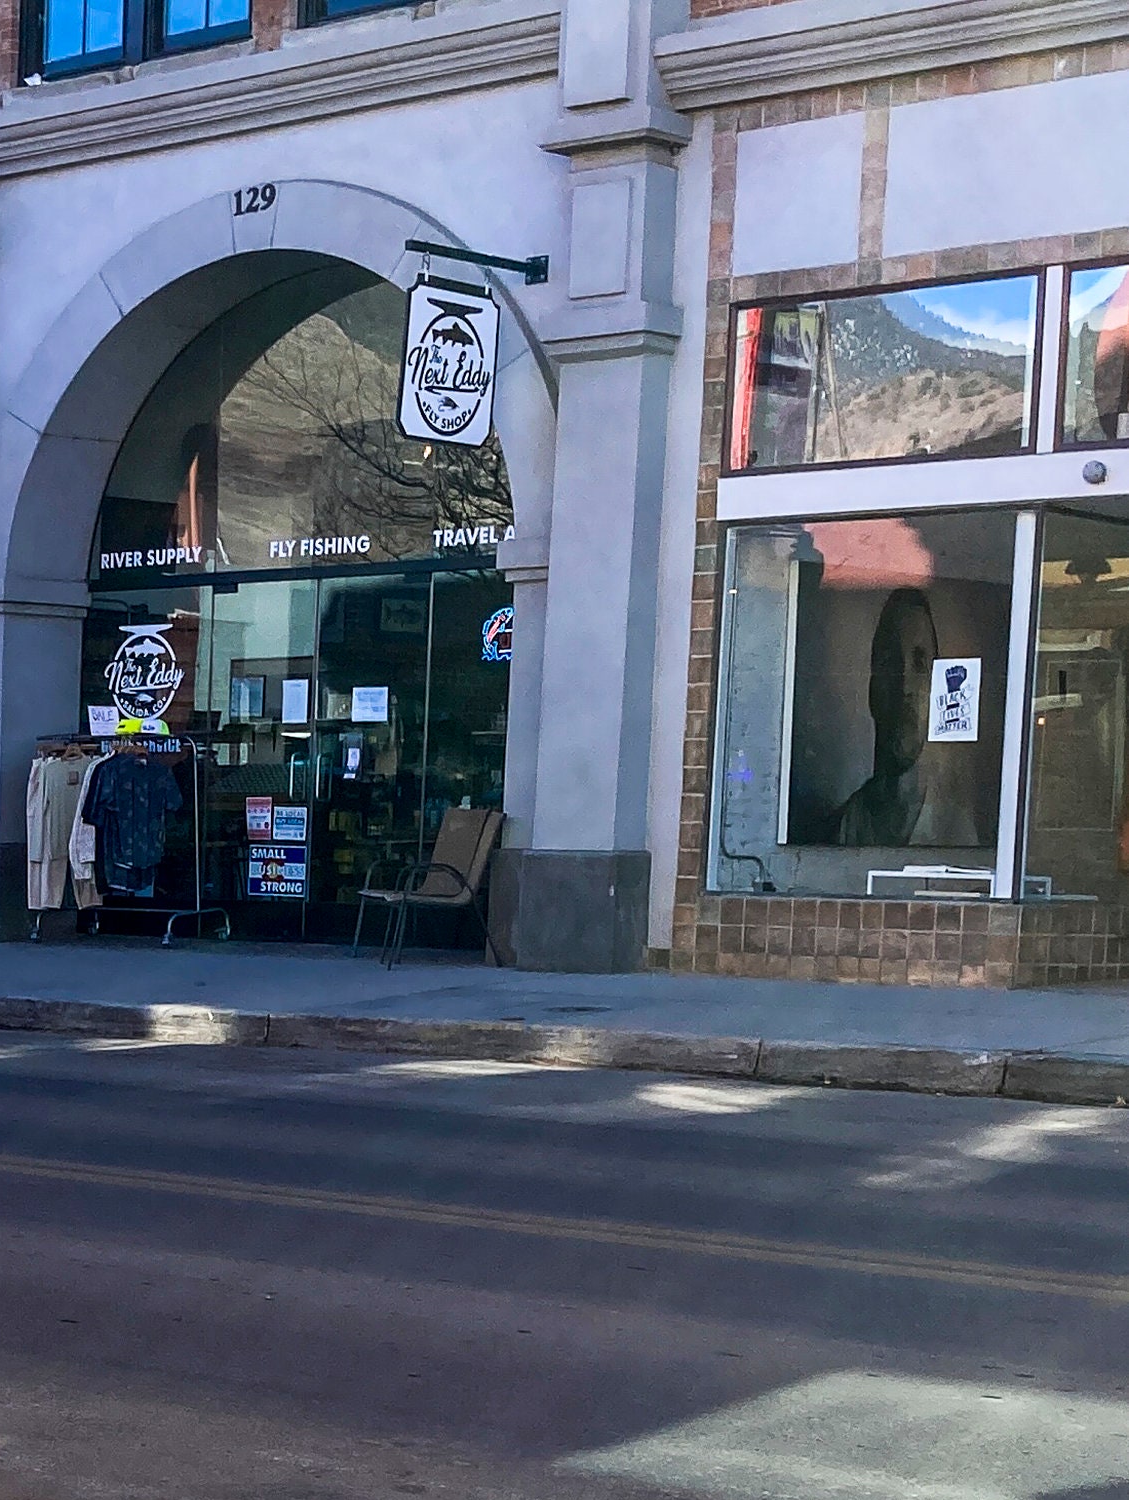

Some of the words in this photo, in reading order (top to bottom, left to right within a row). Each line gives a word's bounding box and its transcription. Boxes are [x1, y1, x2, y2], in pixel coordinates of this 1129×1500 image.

[233, 183, 276, 216] 129
[428, 344, 443, 365] The
[407, 346, 449, 391] Next
[452, 350, 491, 397] Eddy
[423, 404, 439, 424] FLY
[440, 411, 468, 429] SHOP
[269, 540, 296, 558] FLY
[300, 535, 371, 556] FISHING
[432, 525, 499, 548] TRAVEL
[100, 551, 142, 569] RIVER
[146, 546, 202, 566] SUPPLY
[104, 660, 143, 694] Next
[146, 657, 185, 689] Eddy
[124, 658, 137, 672] The
[152, 701, 164, 713] CO
[939, 690, 967, 706] BLACK
[942, 705, 965, 721] LIVES
[937, 720, 968, 732] MATTER
[251, 848, 286, 859] SMALL
[260, 881, 303, 893] STRONG
